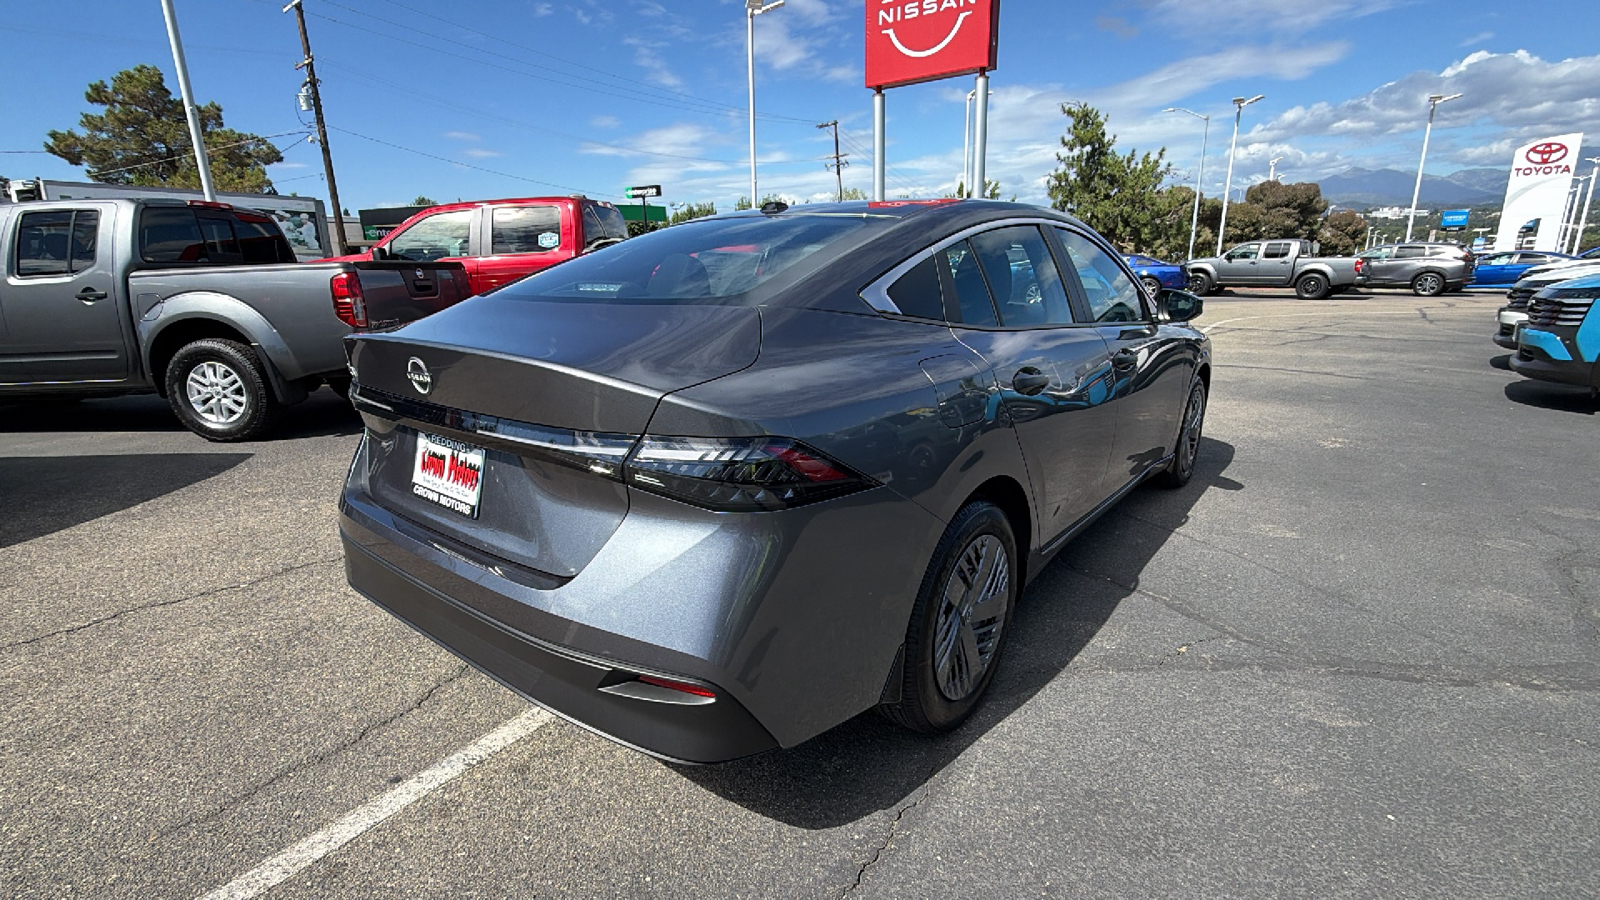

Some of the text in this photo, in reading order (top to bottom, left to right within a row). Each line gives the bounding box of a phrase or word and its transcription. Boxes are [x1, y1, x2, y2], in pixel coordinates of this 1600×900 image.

[1514, 164, 1571, 177] TOYOTA
[431, 434, 467, 453] REDDING
[420, 448, 447, 480] Crown
[446, 450, 480, 492] Motors
[413, 484, 439, 502] CROWN
[439, 494, 471, 515] MOTORS
